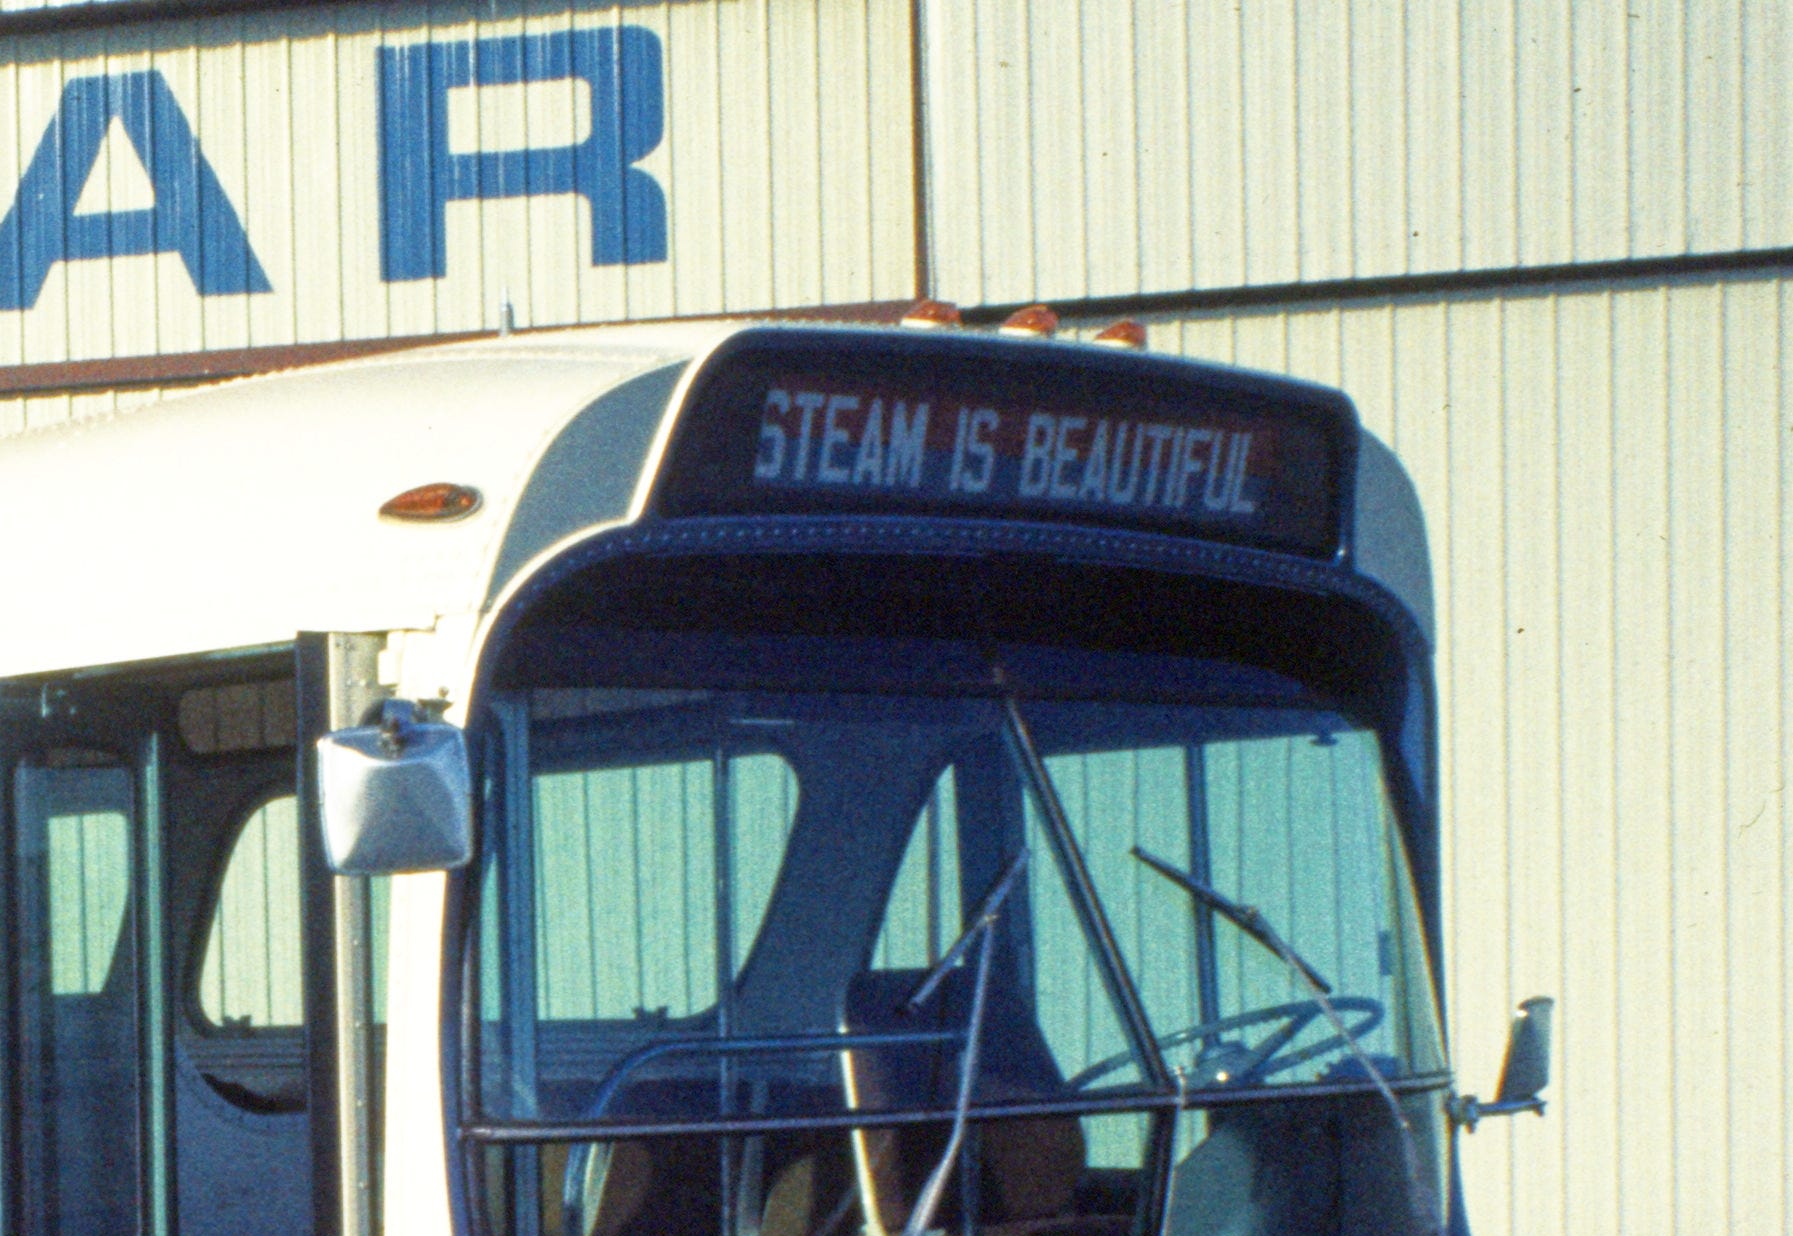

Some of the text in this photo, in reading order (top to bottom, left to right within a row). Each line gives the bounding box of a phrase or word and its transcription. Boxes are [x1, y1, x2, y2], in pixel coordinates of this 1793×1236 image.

[753, 389, 1255, 514] STEAM IS BEAUTIFUL
